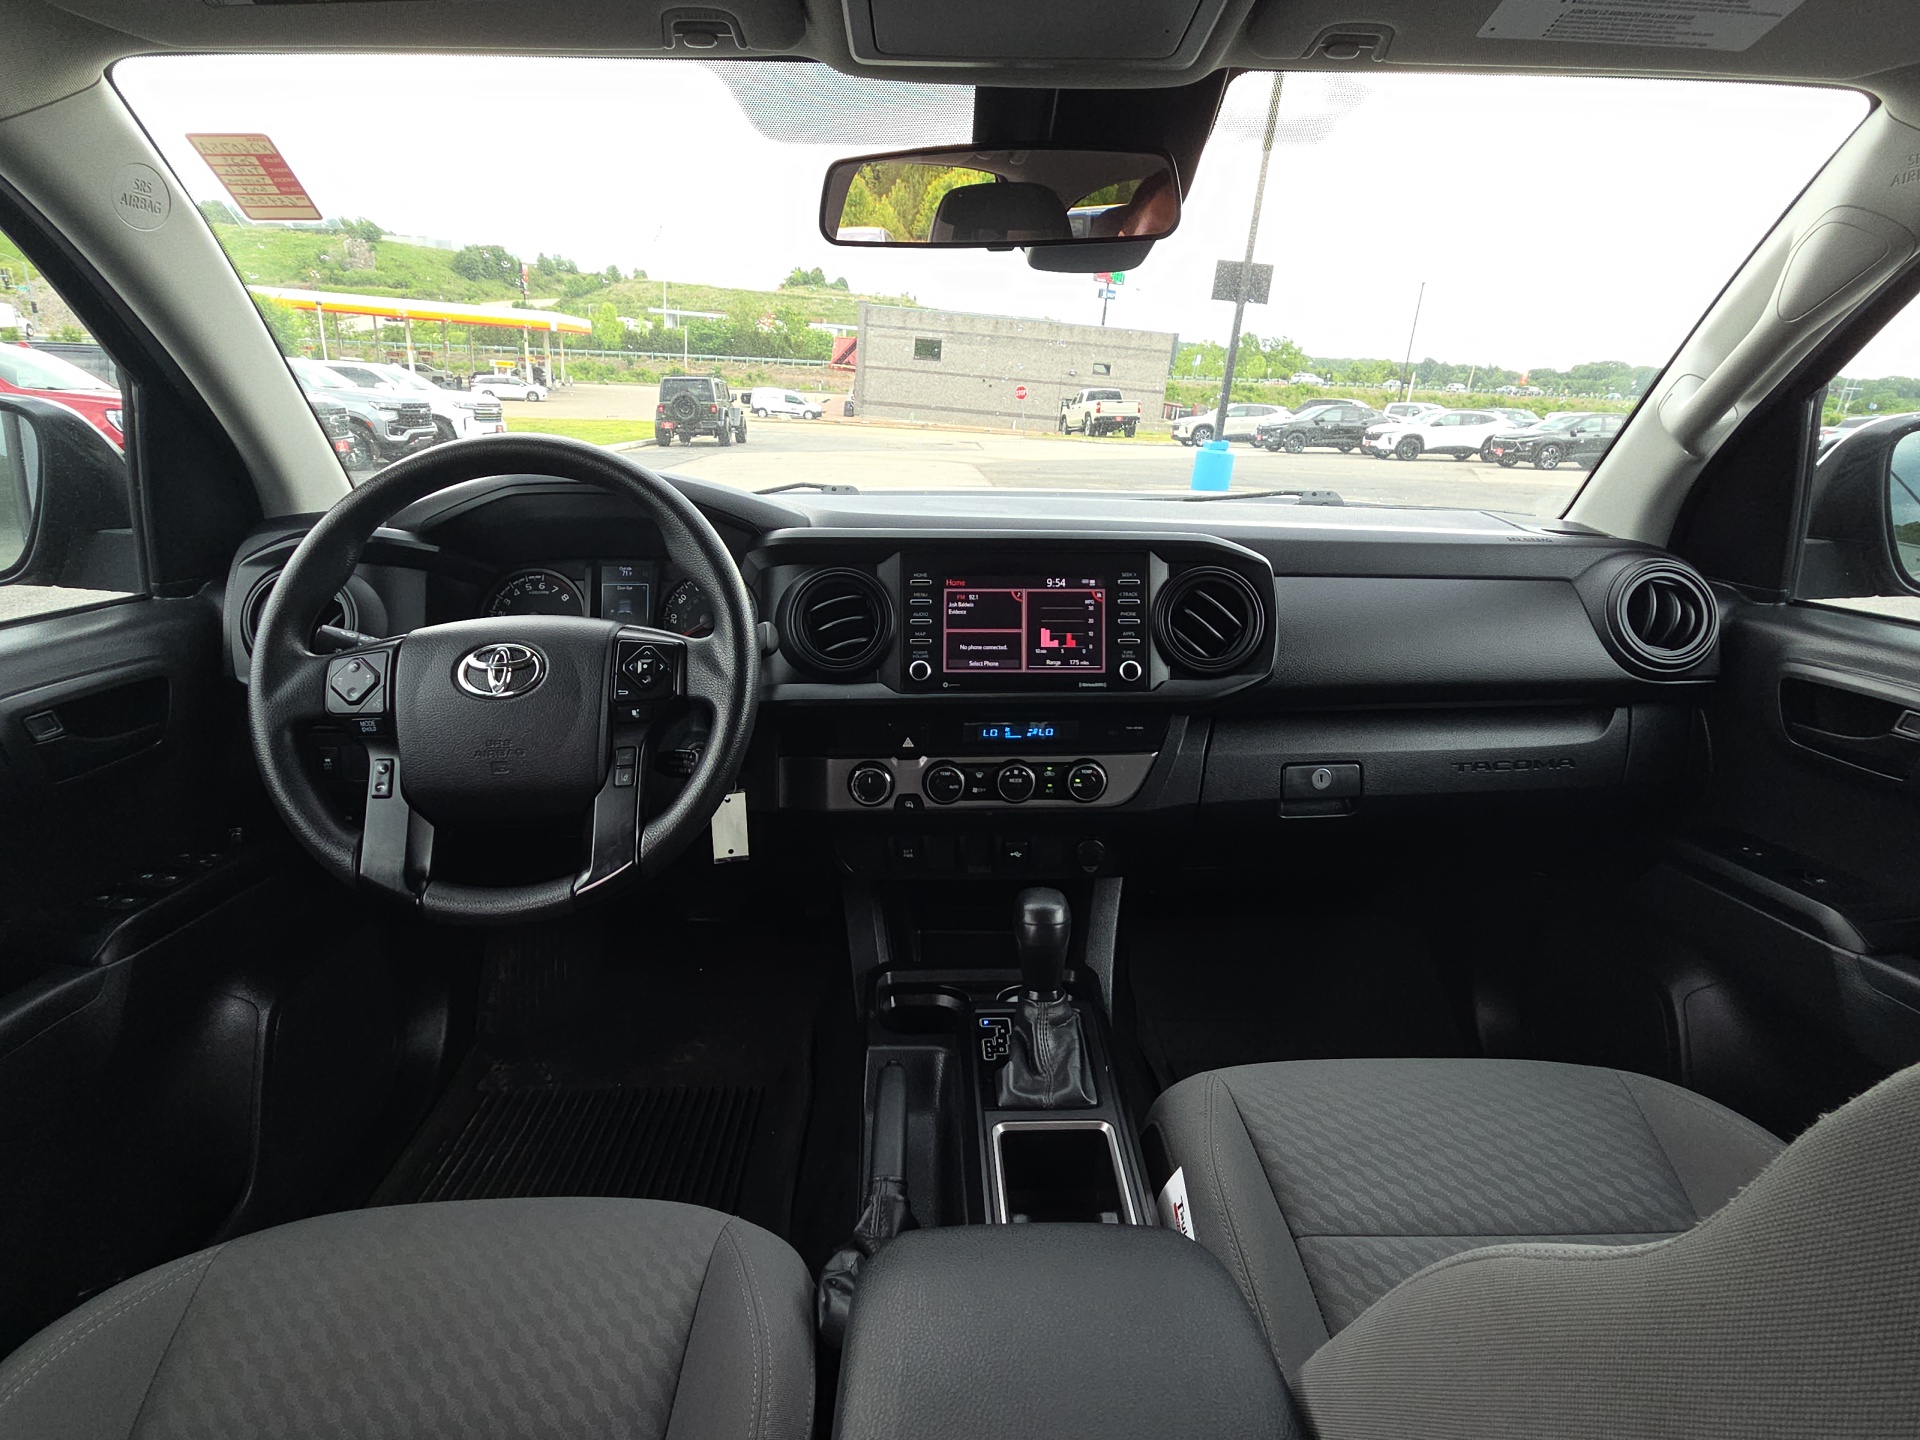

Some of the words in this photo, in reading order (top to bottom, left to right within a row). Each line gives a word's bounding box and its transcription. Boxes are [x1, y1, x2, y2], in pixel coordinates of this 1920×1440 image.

[1890, 169, 1920, 187] AIR
[133, 178, 152, 193] SRS
[120, 193, 161, 214] AIRBAG
[1015, 389, 1027, 397] STOP
[524, 583, 533, 591] 5
[538, 582, 546, 590] 6
[946, 579, 966, 587] Home
[1046, 578, 1066, 588] 9:54
[513, 588, 521, 597] 4
[551, 585, 559, 593] 7
[503, 598, 511, 606] 3
[561, 593, 570, 602] 8
[678, 594, 687, 604] 40
[670, 613, 678, 624] 20
[1451, 758, 1577, 773] TACOMA
